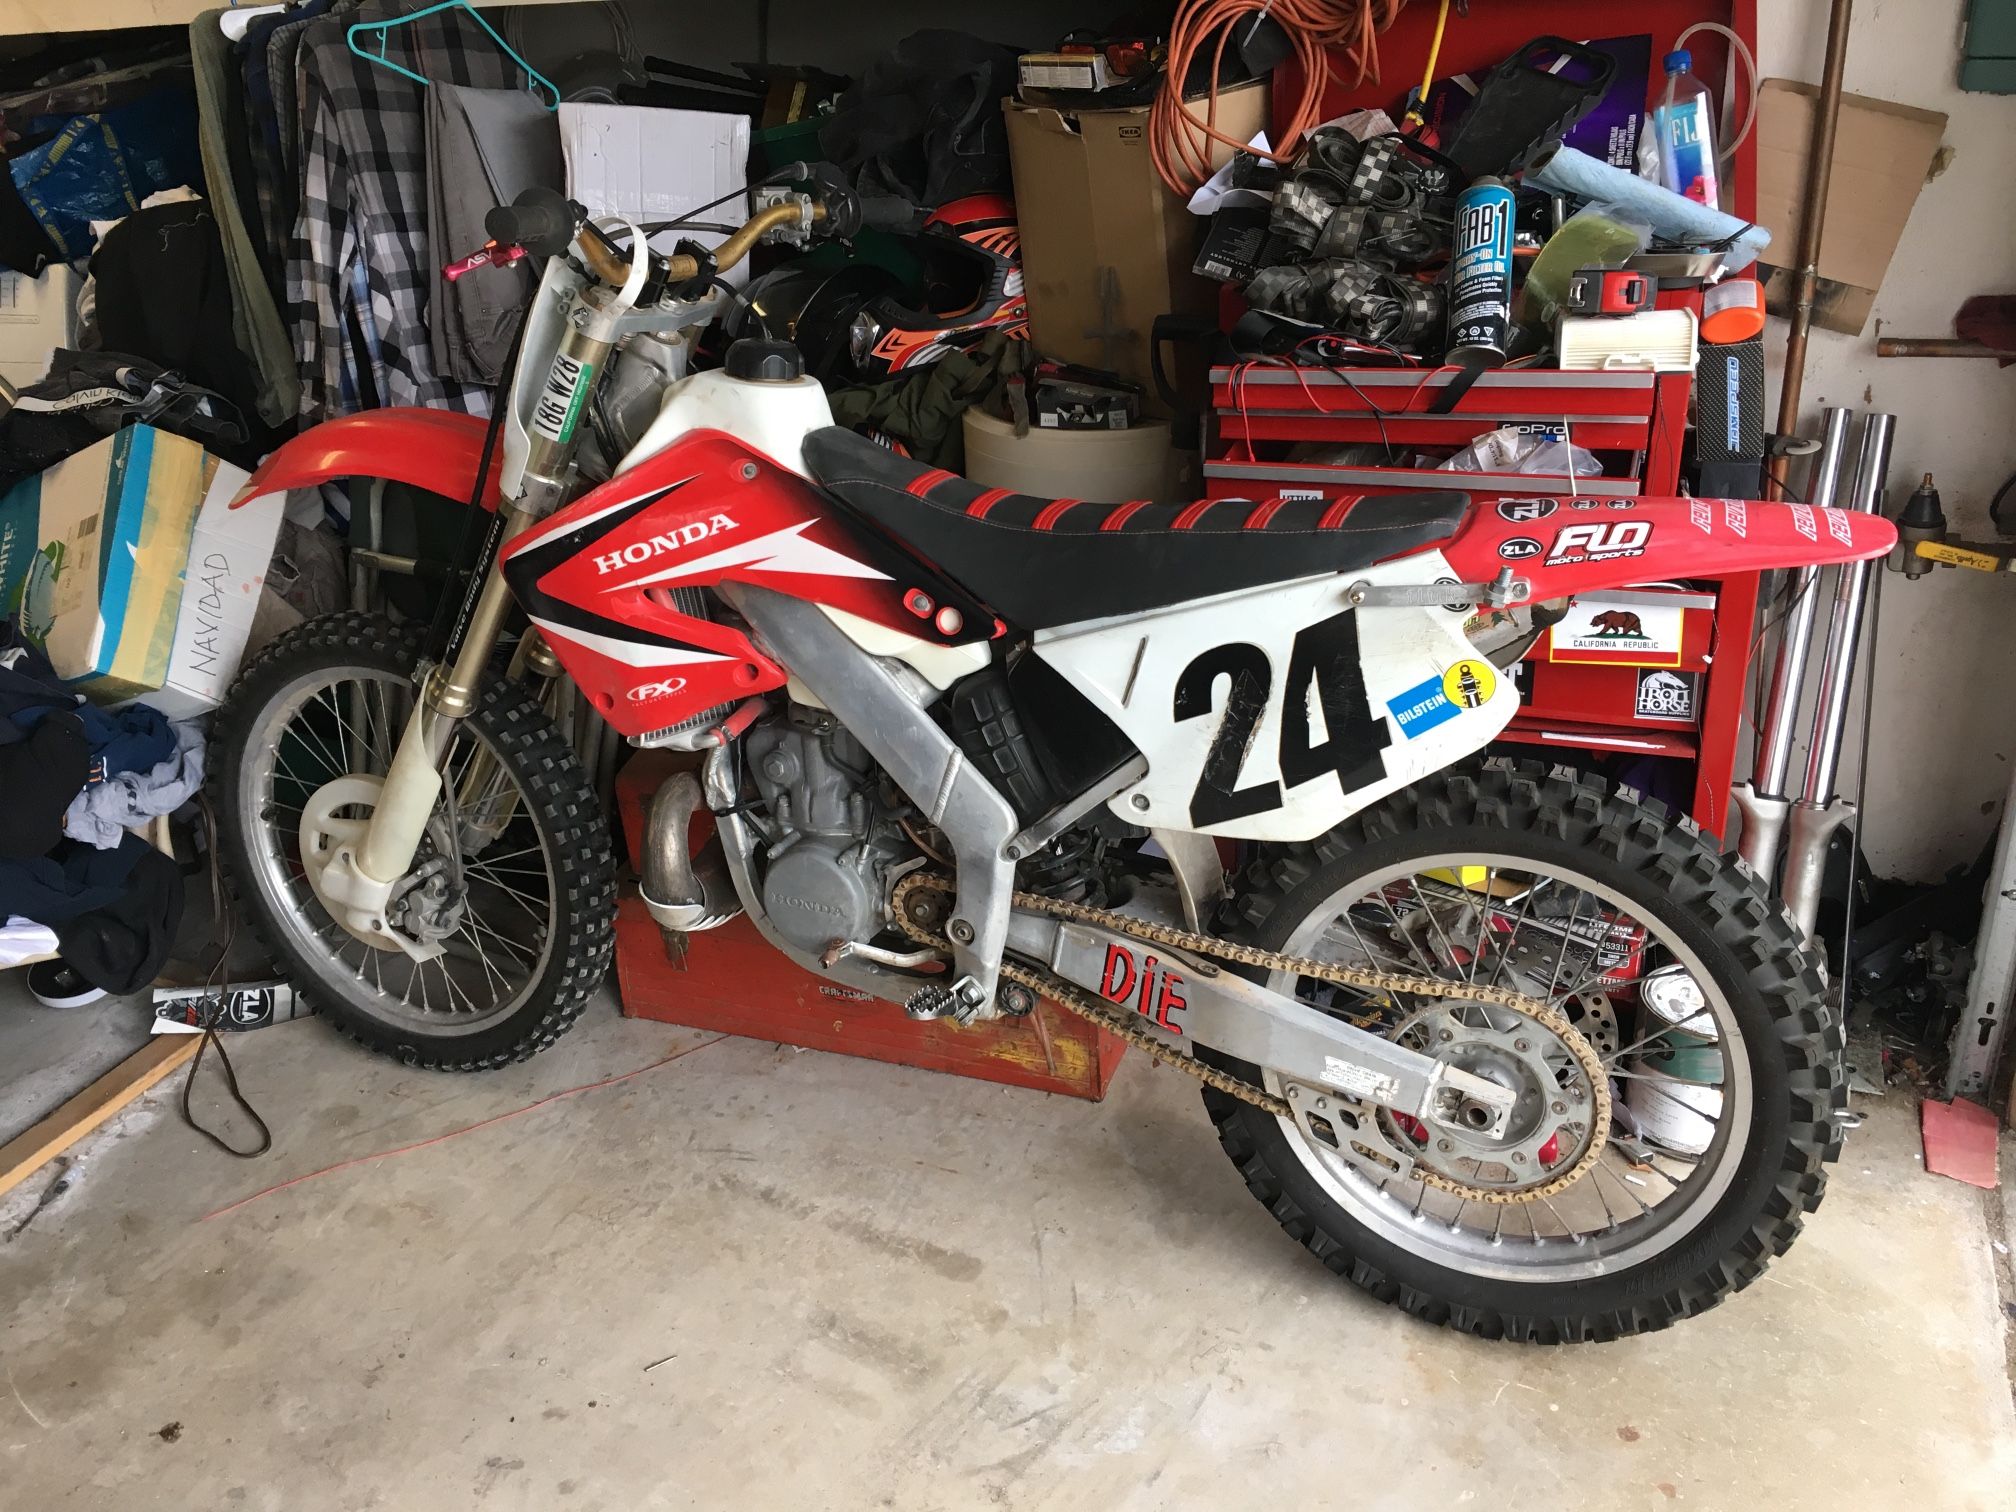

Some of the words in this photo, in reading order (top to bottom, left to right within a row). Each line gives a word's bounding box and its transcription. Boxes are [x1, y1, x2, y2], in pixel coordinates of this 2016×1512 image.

[1671, 114, 1700, 146] FIJ
[467, 249, 492, 269] ASV
[546, 354, 580, 398] W28
[534, 396, 567, 434] 18G
[592, 513, 740, 575] HONDA
[1503, 544, 1534, 555] ZLA
[1549, 521, 1651, 558] FLO
[1546, 555, 1583, 566] moto
[1589, 549, 1644, 562] sports
[450, 614, 467, 650] Valve
[478, 519, 501, 576] System
[189, 553, 231, 677] NAVIDAD
[1573, 639, 1617, 648] CALIFORNIA
[1623, 641, 1659, 649] REPUBLIC
[1397, 693, 1447, 725] BILSTEIN
[1638, 699, 1690, 711] HORSE
[1639, 687, 1690, 701] IRON
[1173, 607, 1393, 829] 24
